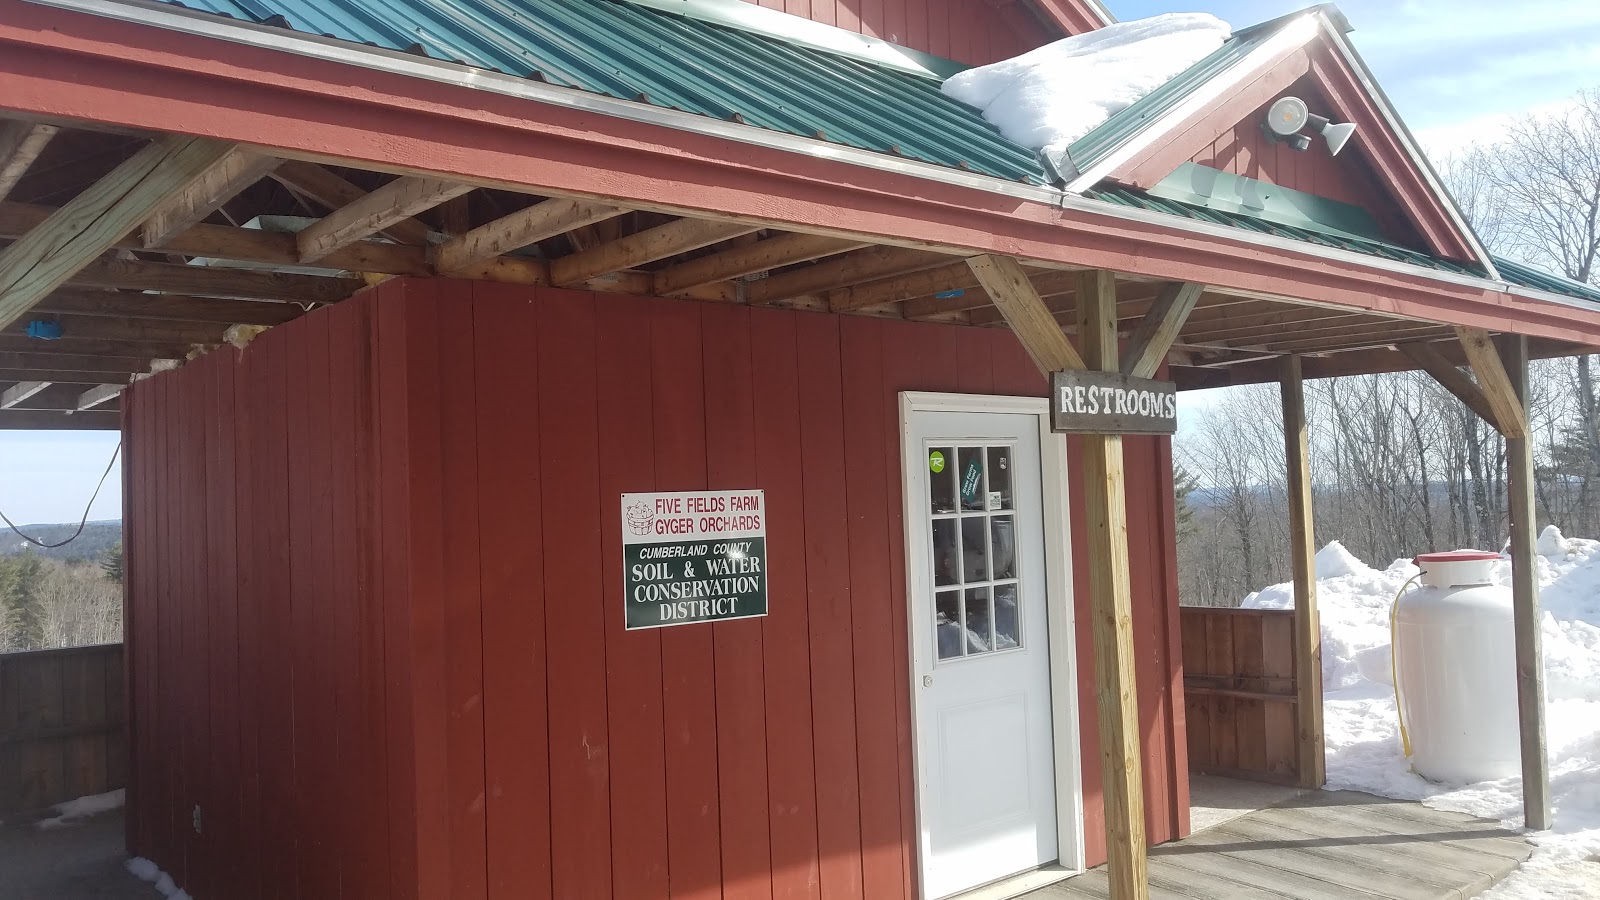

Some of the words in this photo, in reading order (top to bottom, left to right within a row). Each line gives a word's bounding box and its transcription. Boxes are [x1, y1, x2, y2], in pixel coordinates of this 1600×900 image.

[1061, 385, 1175, 418] RESTROOMS
[655, 498, 682, 514] FIVE
[687, 497, 725, 513] FIELDS
[730, 496, 759, 511] FARM
[655, 518, 694, 535] GYGER
[700, 515, 761, 533] ORCHARDS
[639, 544, 708, 559] CUMBERLAND
[713, 542, 752, 555] COUNTY
[632, 562, 673, 582] SOIL
[684, 560, 695, 578] &
[706, 556, 761, 576] WATER
[634, 576, 759, 603] CONSERVATION
[660, 597, 739, 621] DISTRICT
